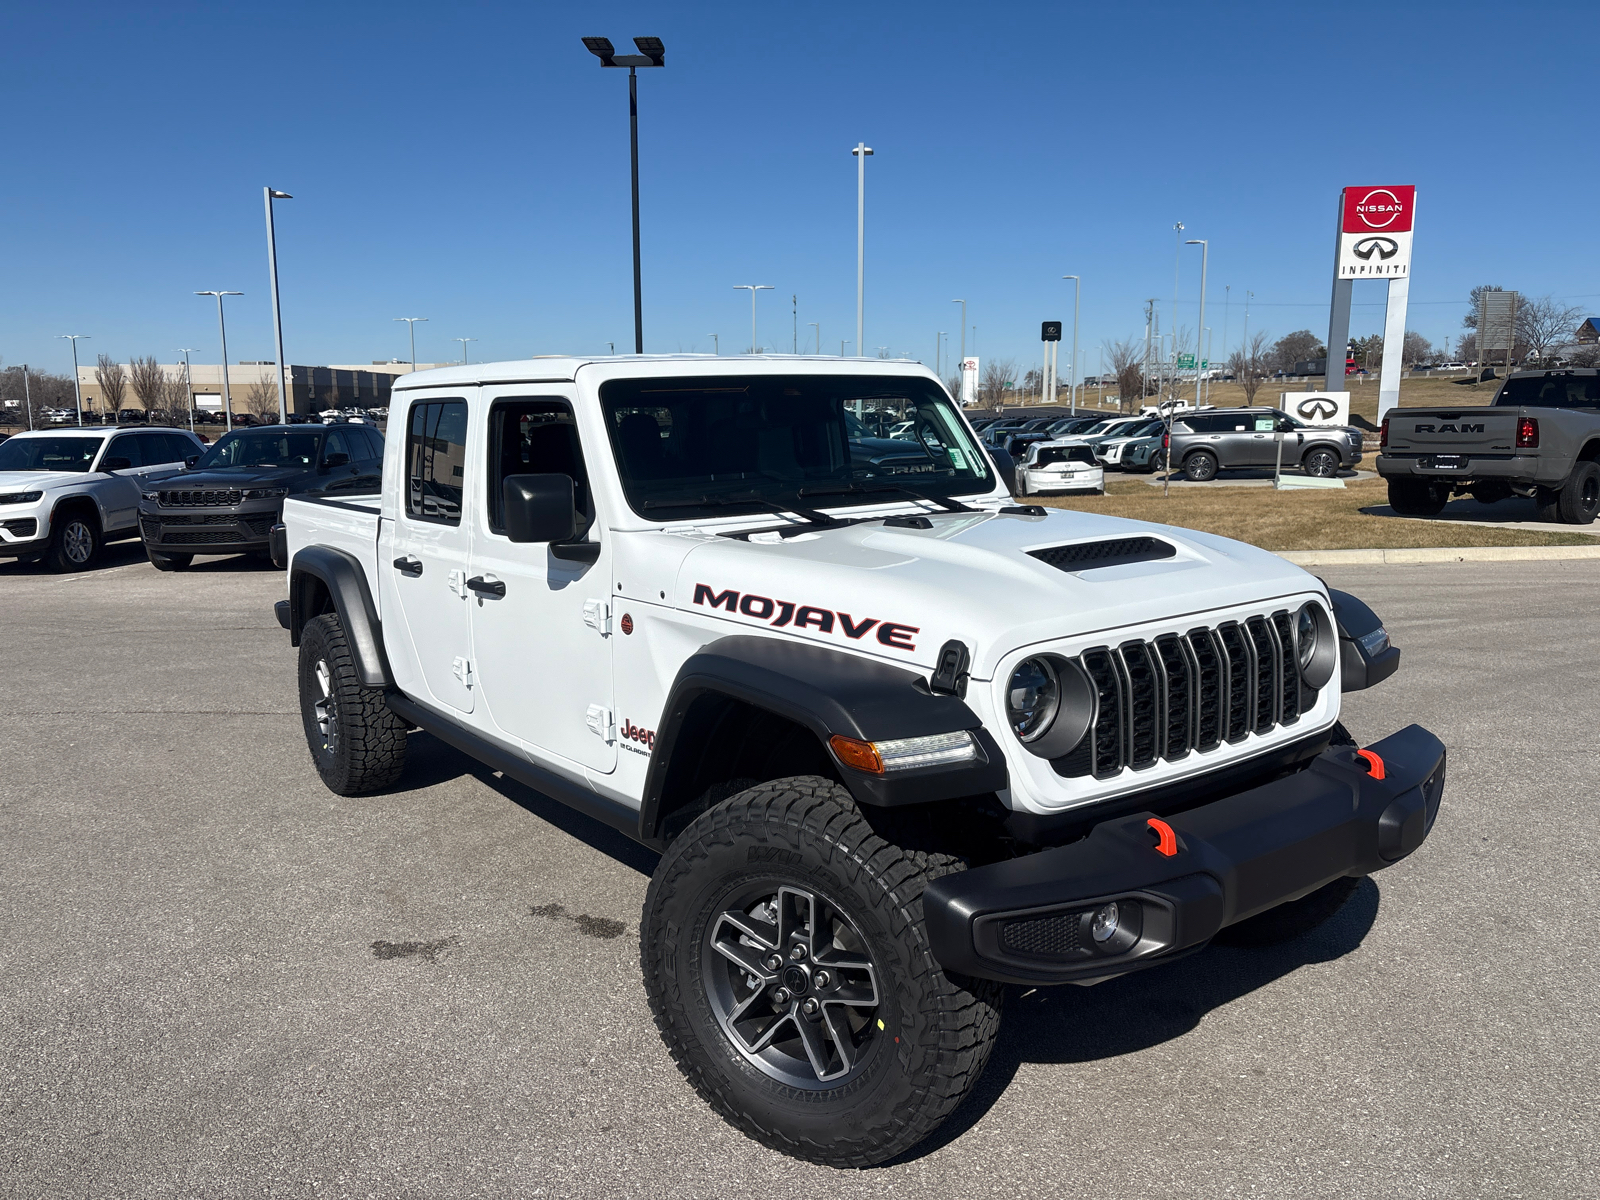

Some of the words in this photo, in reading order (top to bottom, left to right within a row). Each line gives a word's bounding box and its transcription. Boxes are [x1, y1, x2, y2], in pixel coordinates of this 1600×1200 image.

[1342, 265, 1406, 275] INFINITI
[1414, 423, 1485, 434] RAM
[896, 463, 932, 474] RAM
[693, 583, 920, 652] MOJAVE
[620, 718, 656, 751] Jeep
